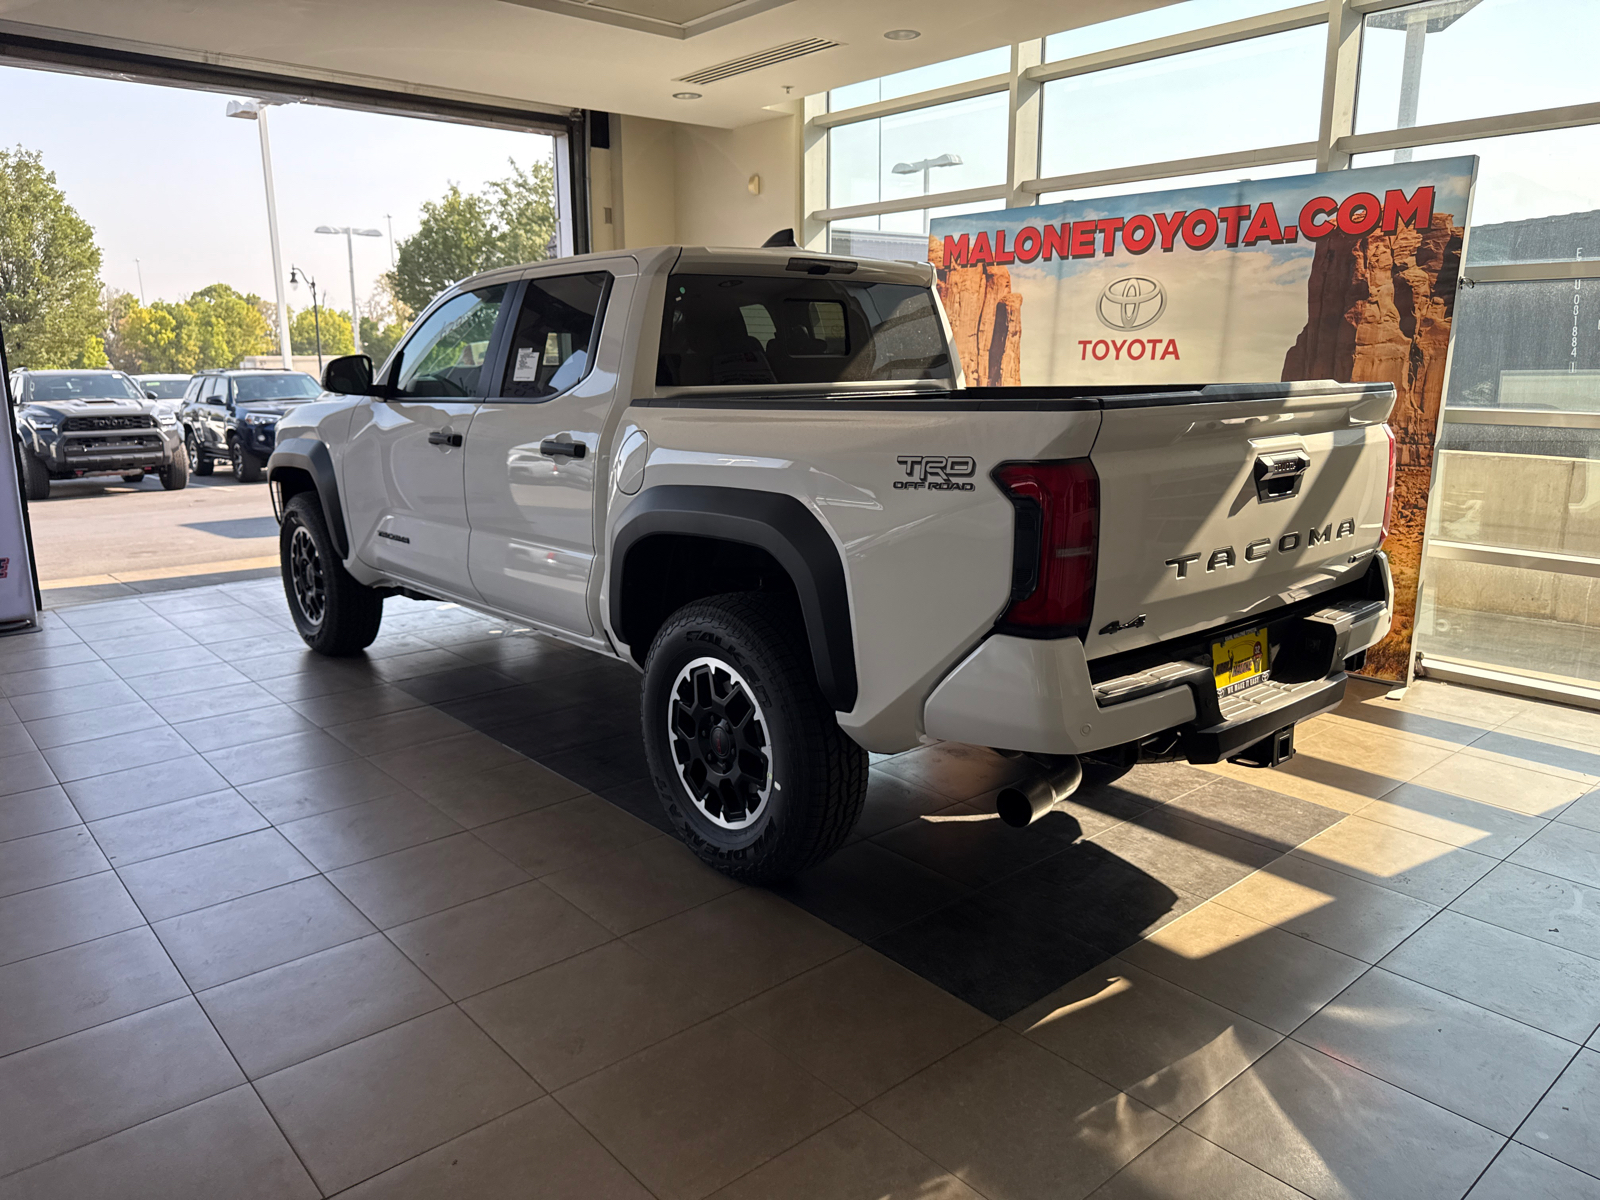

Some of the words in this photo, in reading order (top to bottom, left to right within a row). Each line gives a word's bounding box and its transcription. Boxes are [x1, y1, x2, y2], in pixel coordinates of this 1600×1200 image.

[942, 185, 1437, 268] MALONETOYOTA.COM
[1078, 338, 1180, 361] TOYOTA
[897, 455, 977, 482] TRD
[893, 481, 926, 491] OFF
[928, 482, 976, 492] ROAD
[1165, 517, 1356, 580] TACOMA
